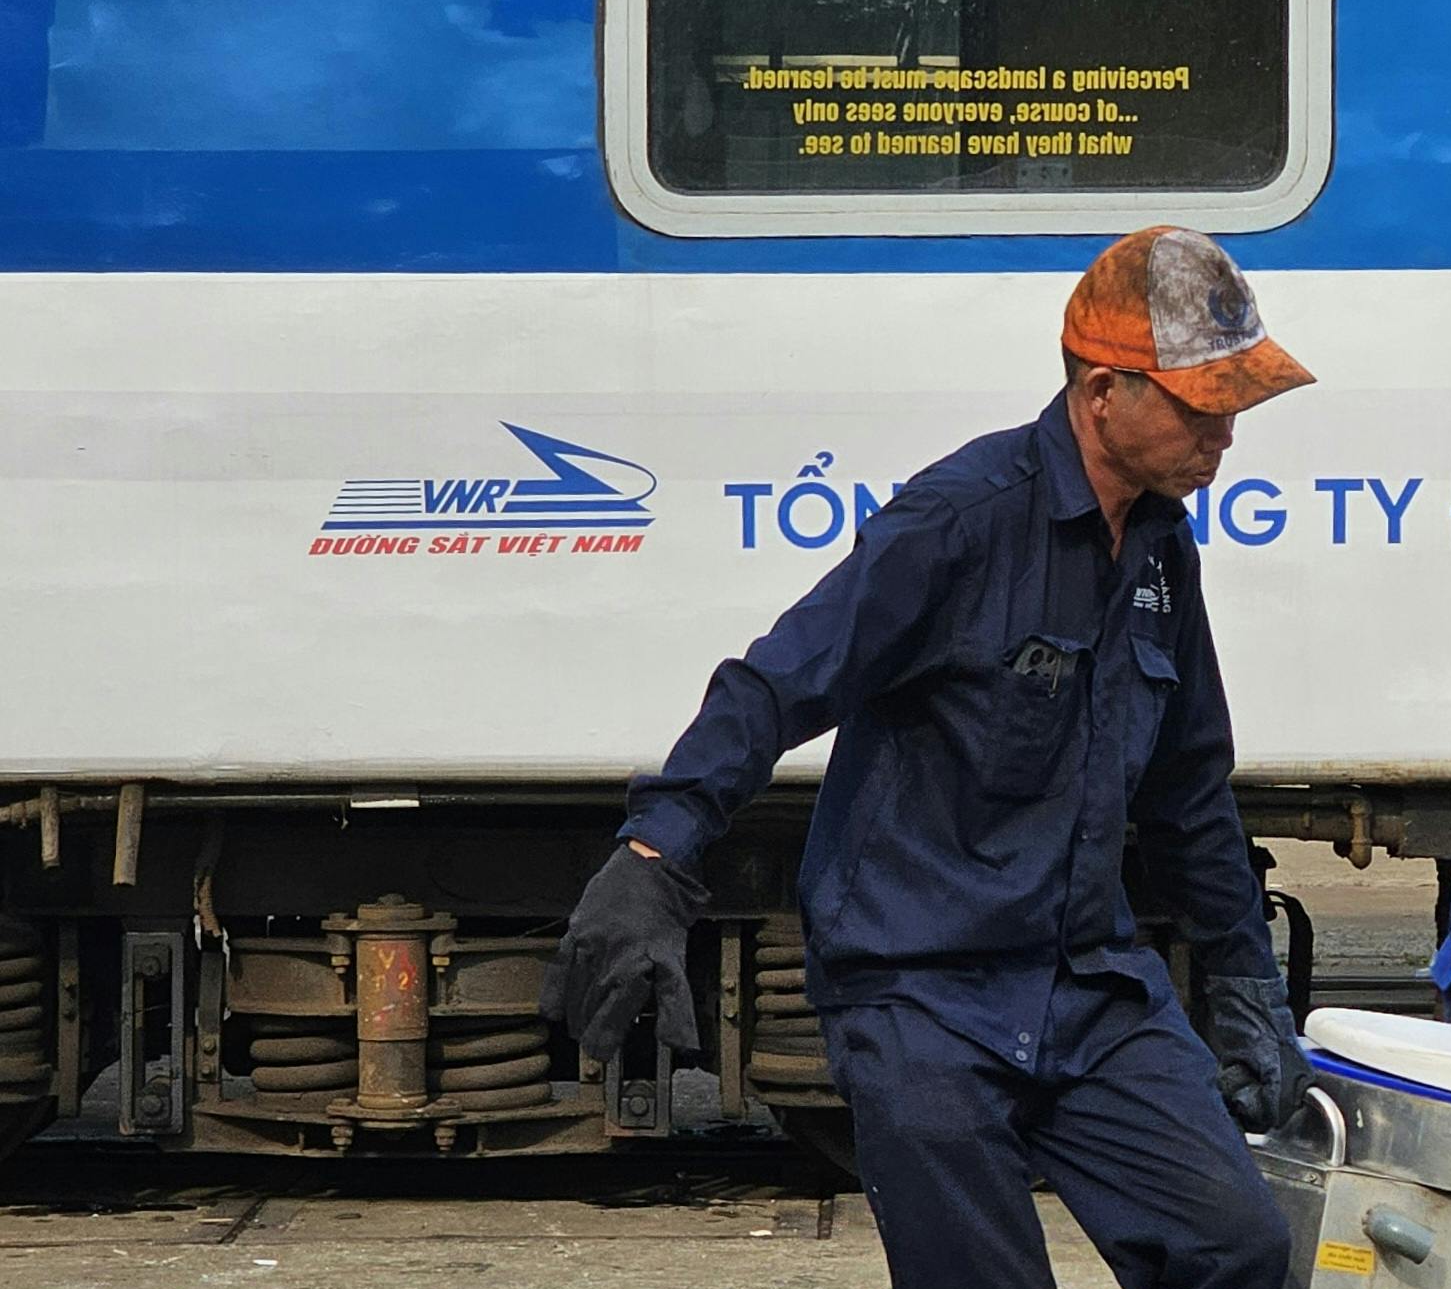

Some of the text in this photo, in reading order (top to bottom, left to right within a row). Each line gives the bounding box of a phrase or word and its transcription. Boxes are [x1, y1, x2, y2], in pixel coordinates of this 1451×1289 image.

[423, 479, 510, 514] VNR
[1315, 477, 1422, 545] TY
[308, 534, 420, 555] ĐƯỜNG
[497, 533, 567, 556] VIỆT
[571, 534, 645, 553] NAM
